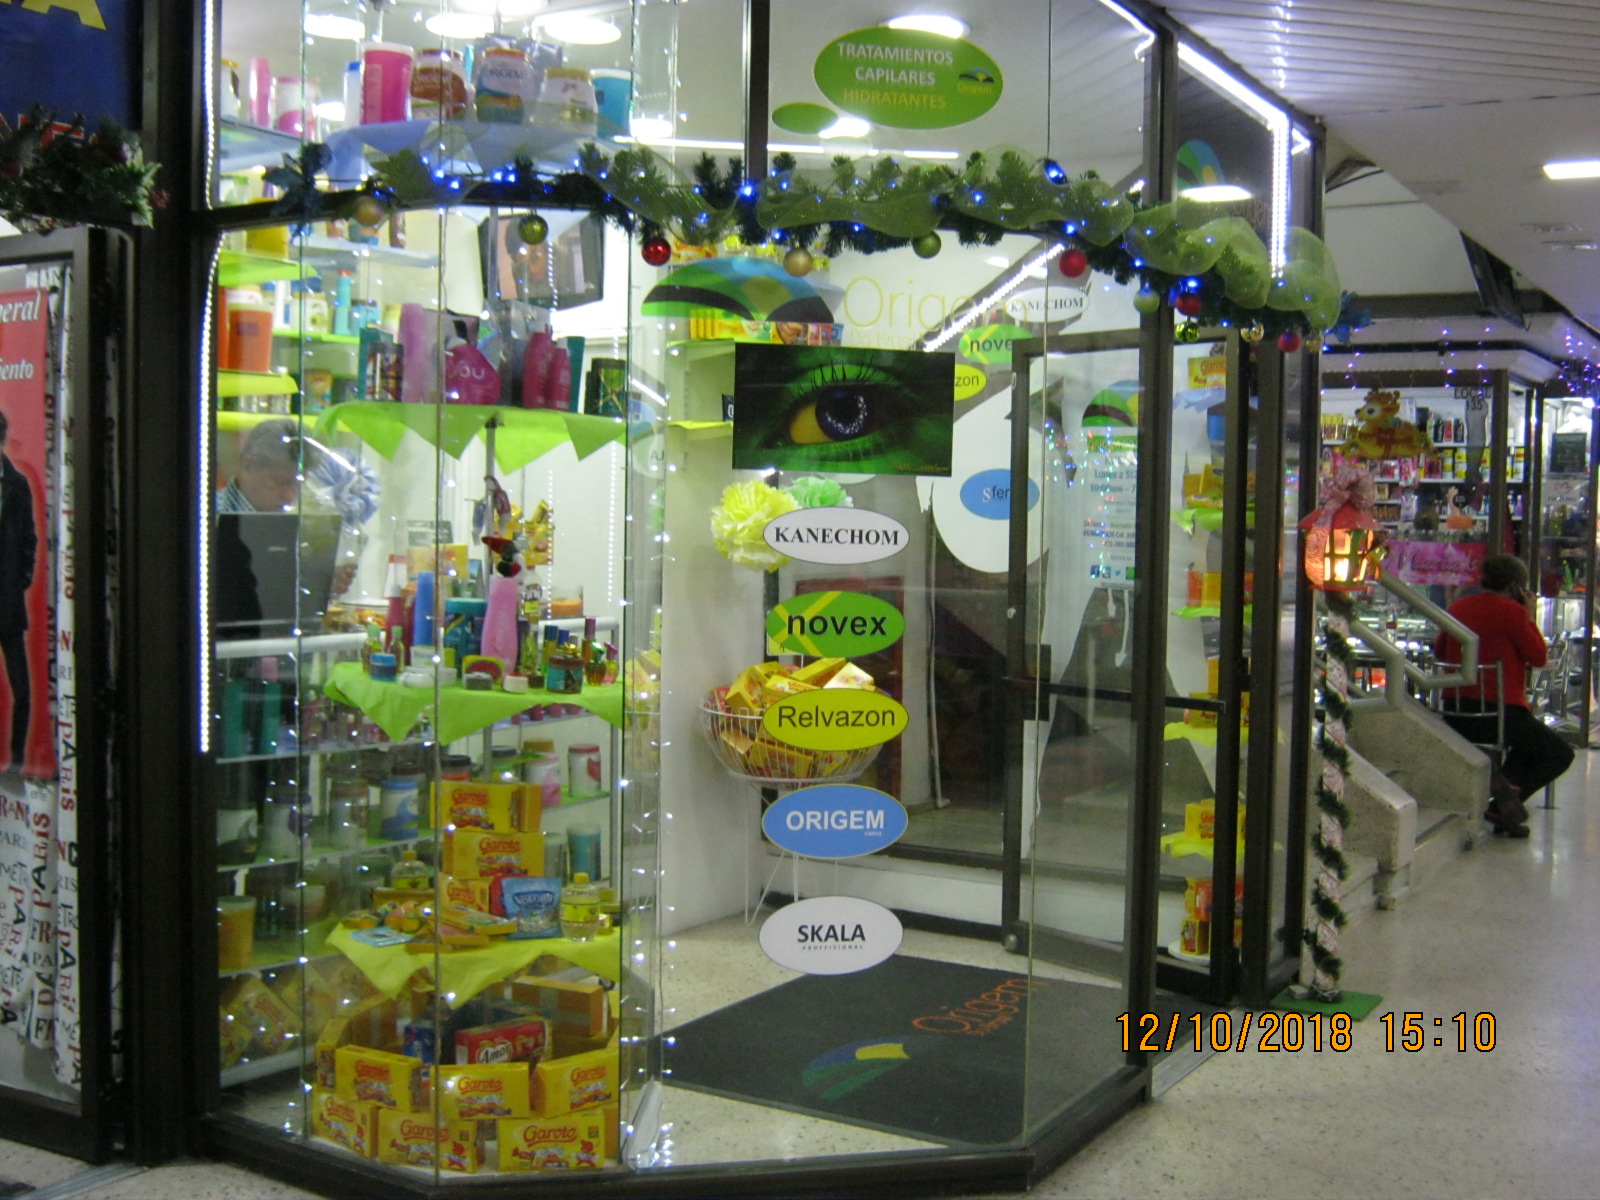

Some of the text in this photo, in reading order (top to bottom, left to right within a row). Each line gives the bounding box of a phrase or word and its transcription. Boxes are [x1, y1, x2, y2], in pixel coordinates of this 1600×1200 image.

[836, 42, 953, 65] TRATAMIENTOS
[855, 66, 936, 86] CAPILARES
[843, 88, 946, 111] HIDRATANTES
[1010, 297, 1084, 314] KANECHOM
[969, 337, 1013, 353] nove
[954, 376, 980, 388] zon
[1454, 386, 1492, 399] LOCAL
[982, 485, 1011, 503] Sfer
[774, 527, 899, 546] KANECHOM
[787, 613, 887, 636] novex
[778, 706, 895, 728] Relvazon
[786, 809, 885, 831] ORIGEM
[797, 924, 866, 943] SKALA
[912, 979, 1050, 1033] Origem
[523, 1125, 577, 1148] Garoto
